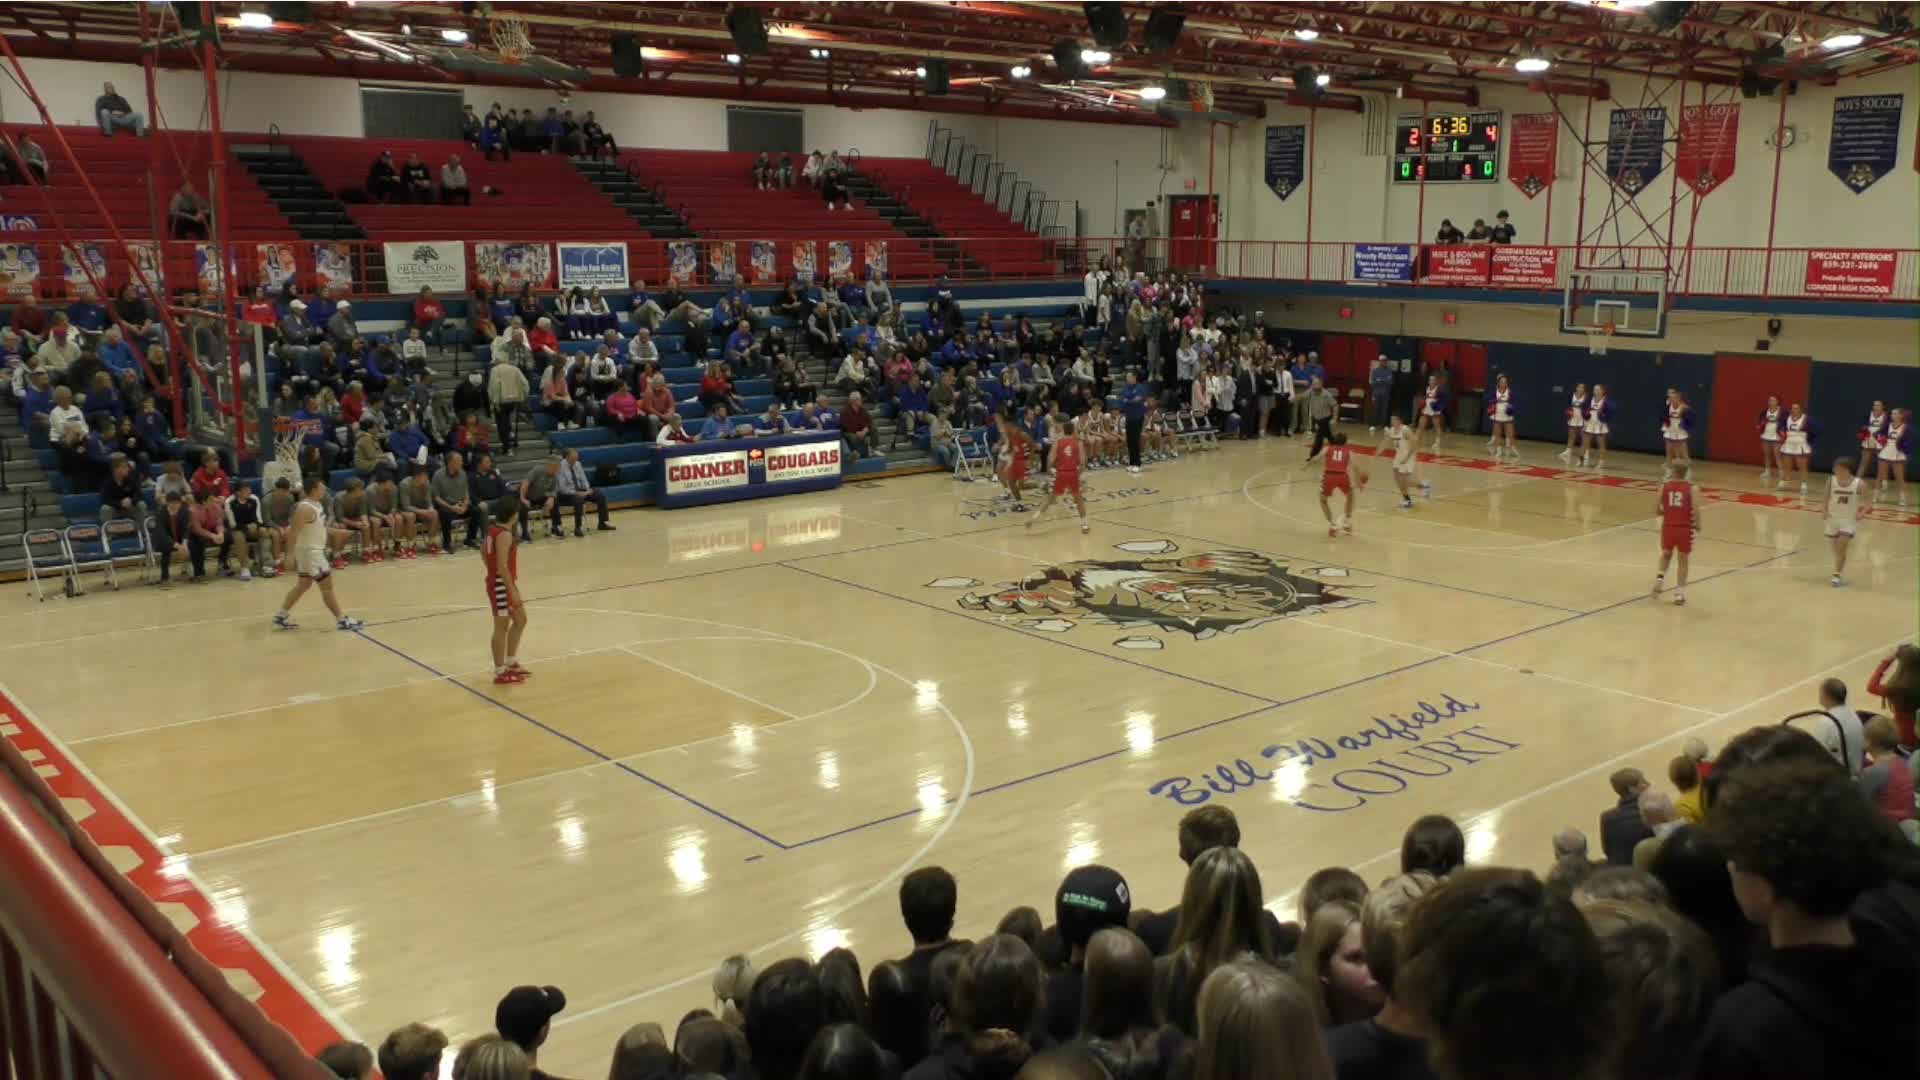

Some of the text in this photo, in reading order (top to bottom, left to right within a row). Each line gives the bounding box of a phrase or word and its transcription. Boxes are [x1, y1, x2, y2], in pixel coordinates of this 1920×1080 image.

[1432, 117, 1468, 135] 6:36
[1485, 125, 1497, 142] 4
[1409, 127, 1420, 145] 2
[1452, 140, 1458, 152] 1
[1401, 162, 1410, 177] 0
[1483, 161, 1493, 176] 0
[1810, 251, 1893, 262] SPECIALTY INTERIORS
[1063, 446, 1073, 457] 4
[1332, 450, 1343, 461] 11
[768, 449, 839, 471] COUGARS
[668, 458, 746, 482] CONNER
[703, 478, 731, 487] SCHOOL
[1668, 491, 1682, 507] 12
[1149, 693, 1480, 806] Bill Warfield
[1294, 725, 1520, 812] COURT
